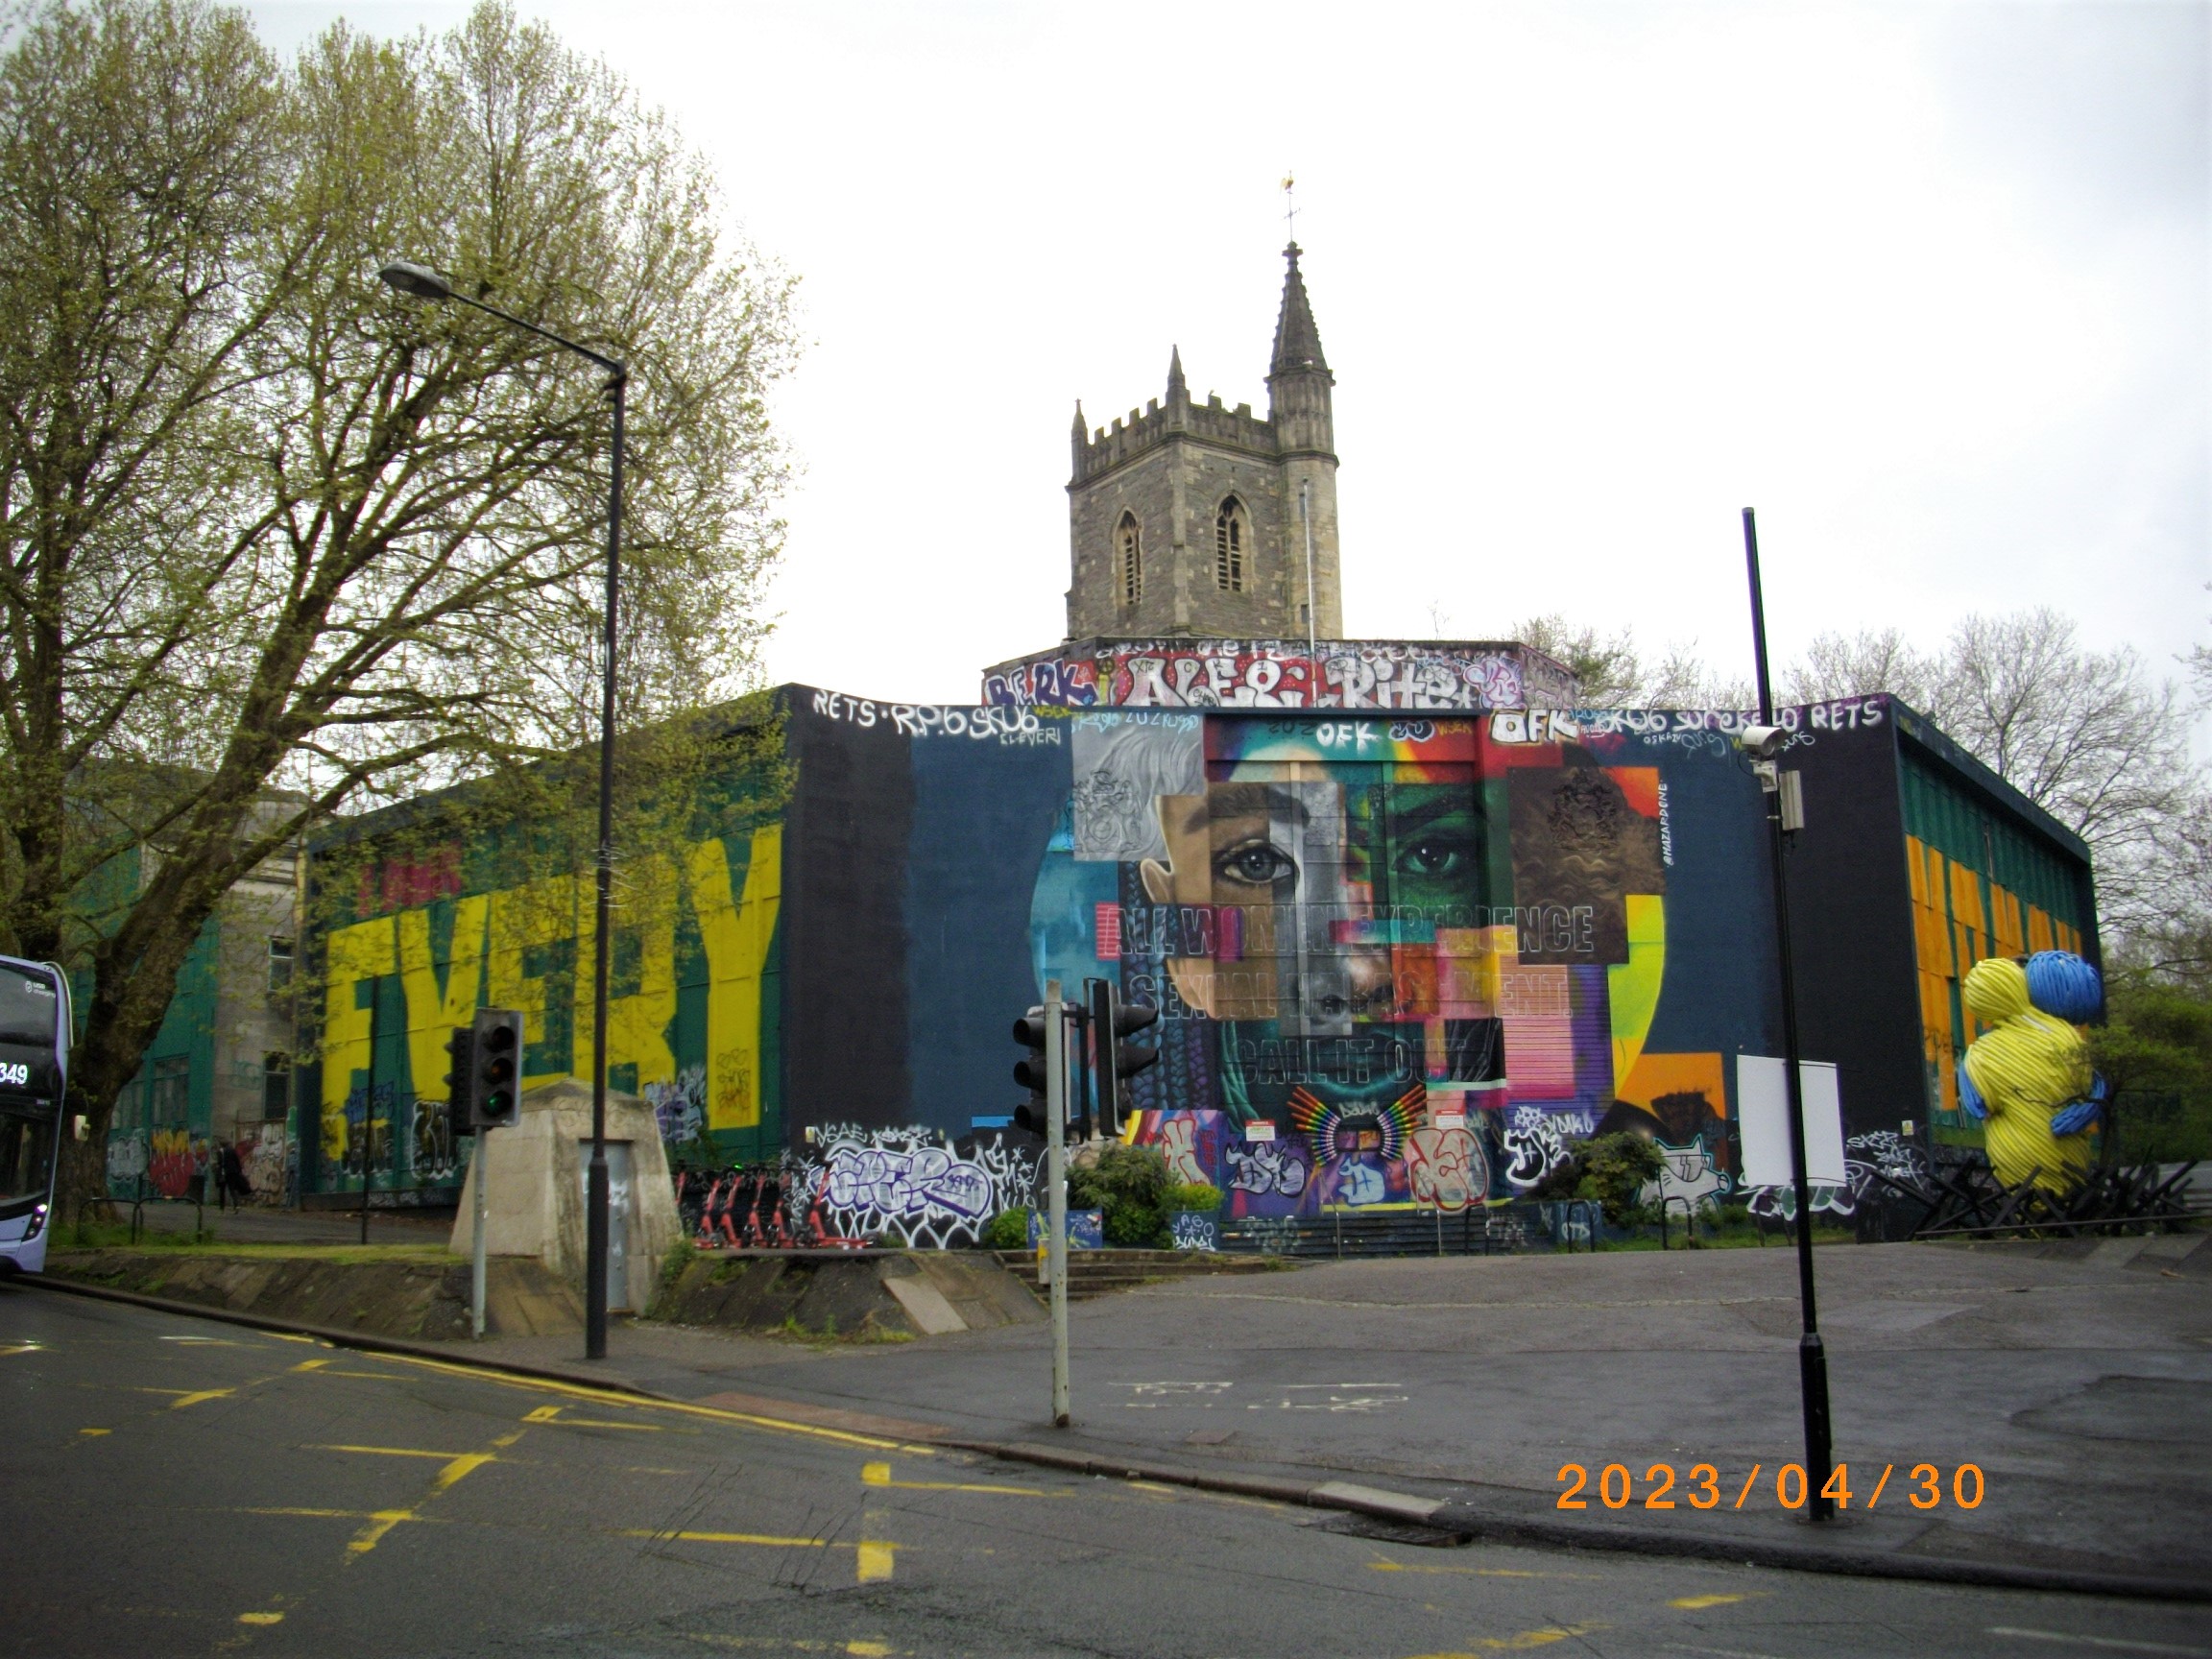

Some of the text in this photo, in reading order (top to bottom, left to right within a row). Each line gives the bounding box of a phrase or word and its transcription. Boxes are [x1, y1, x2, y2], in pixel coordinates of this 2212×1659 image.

[1489, 708, 1579, 746] OFK
[1811, 701, 1883, 732] RETS
[1103, 907, 1175, 956] ALL
[0, 1063, 29, 1085] 349
[1334, 1038, 1375, 1084] IT
